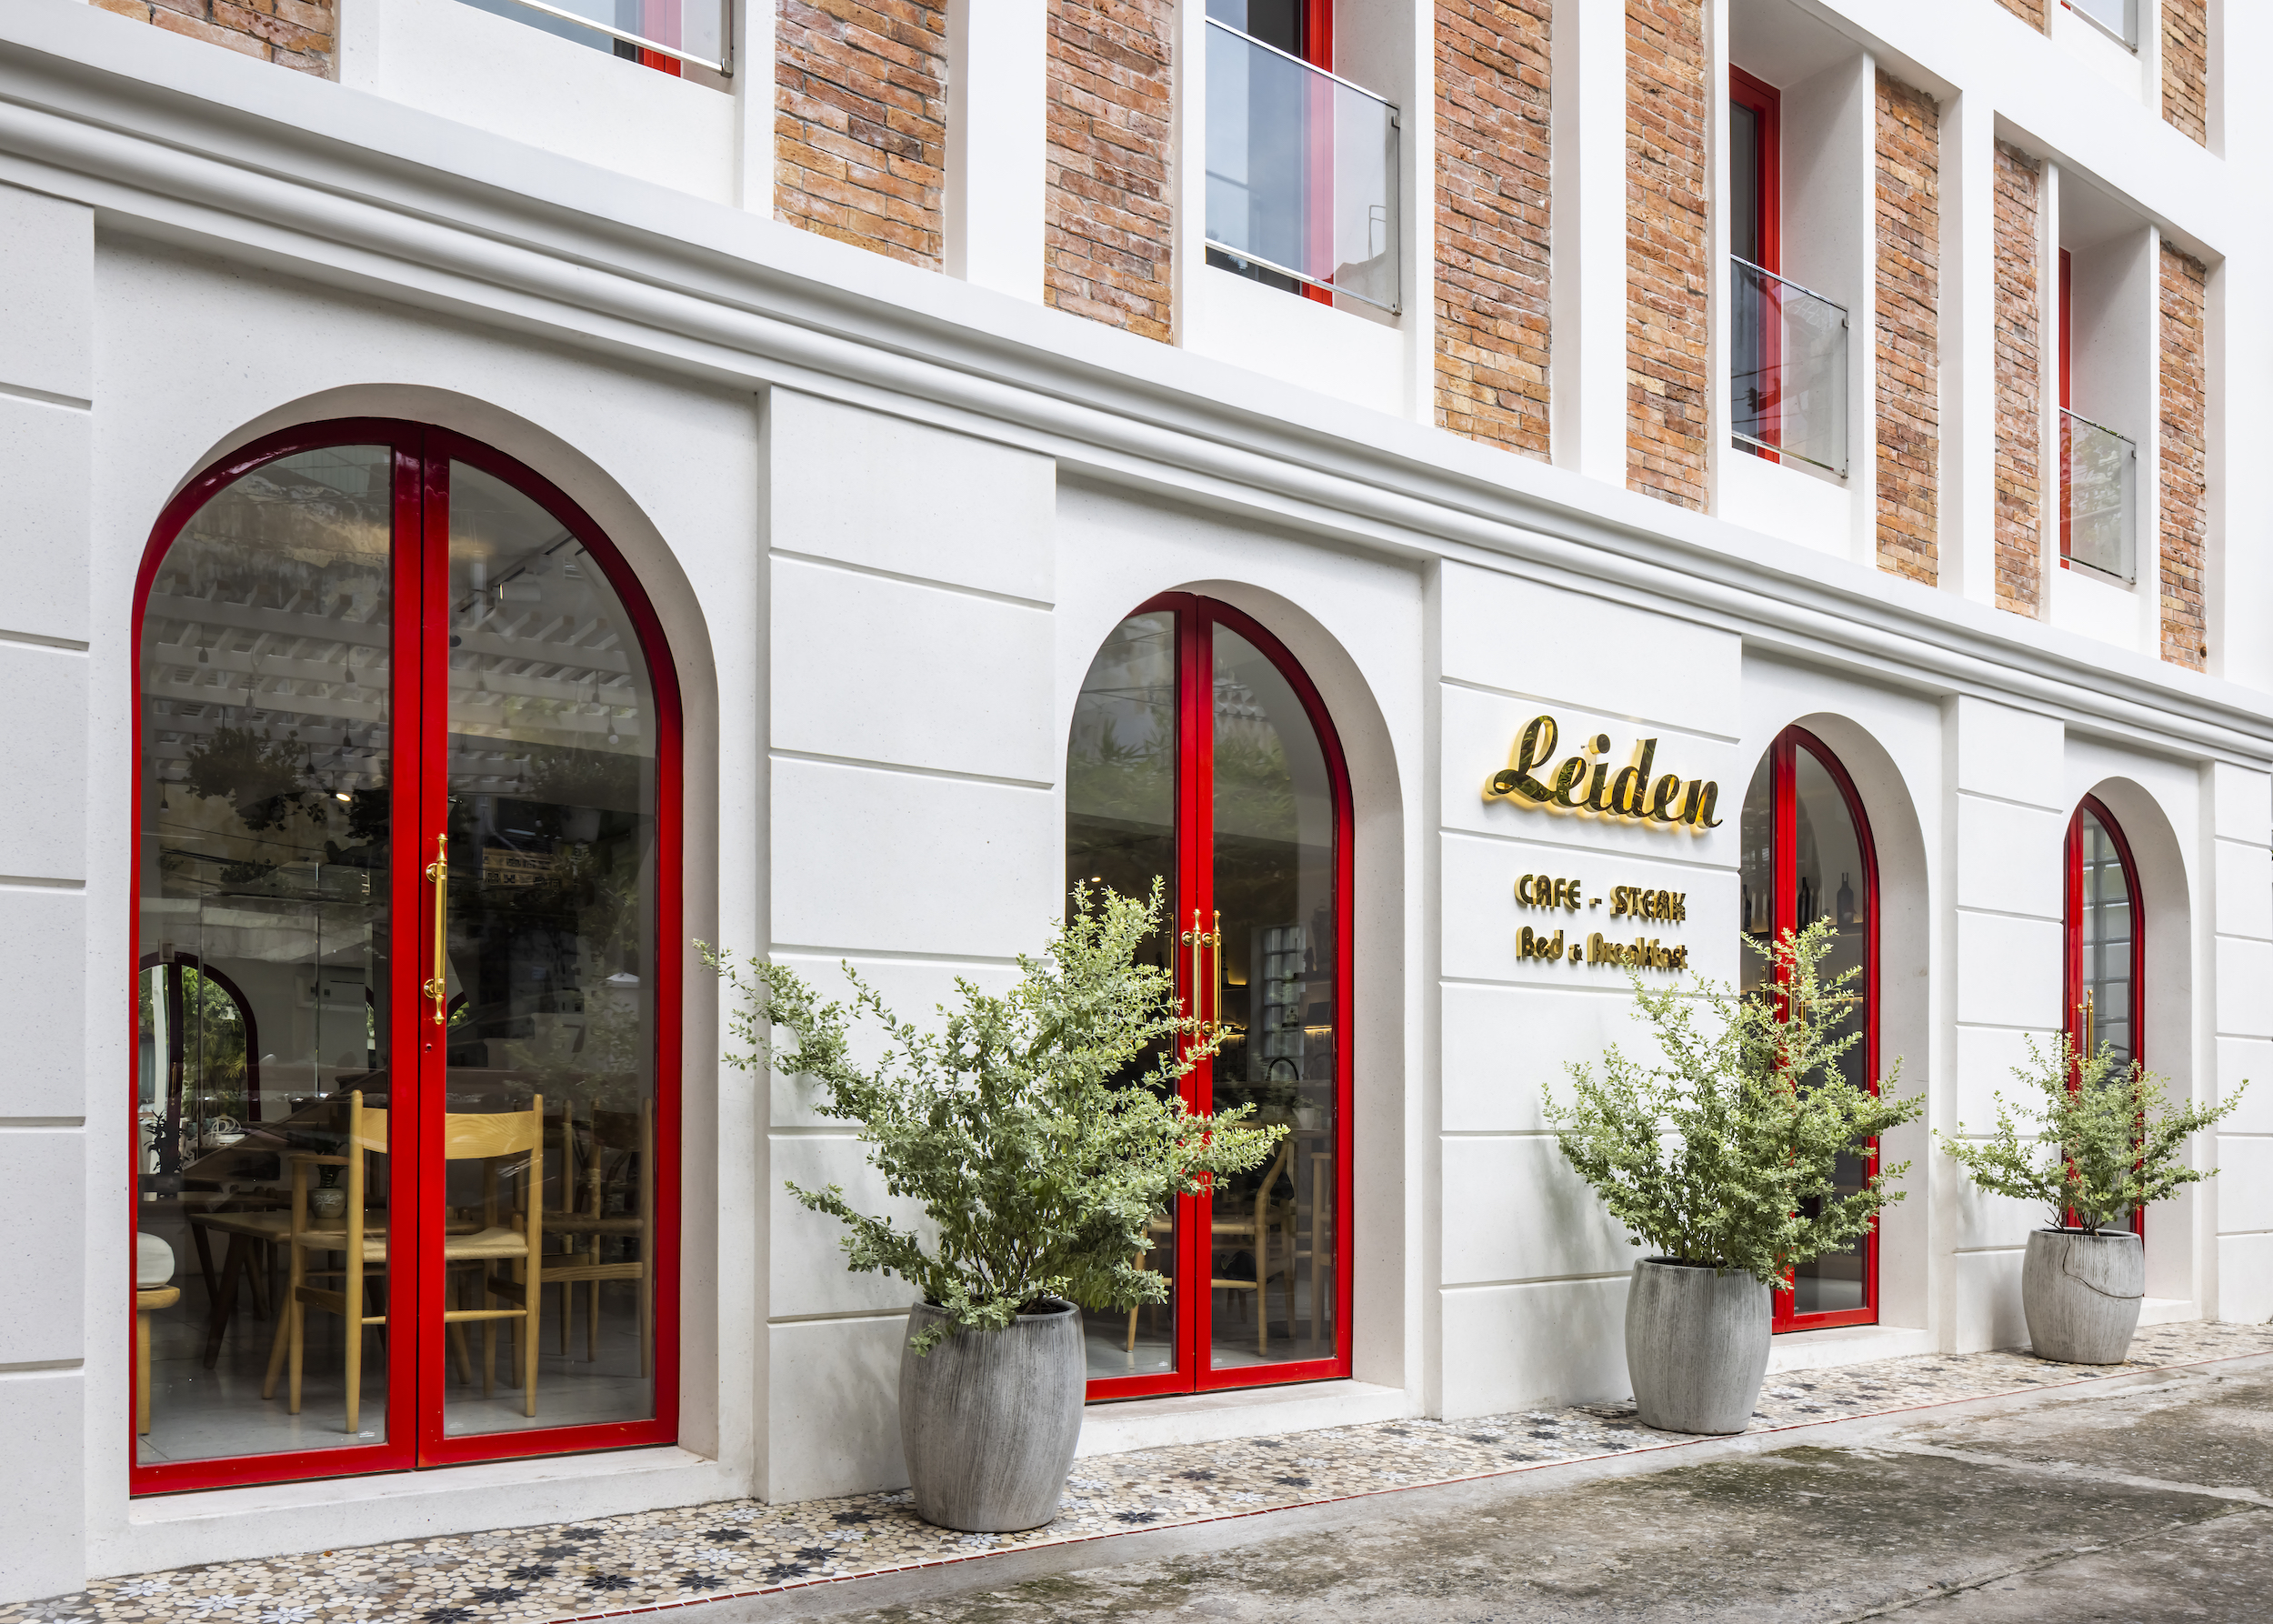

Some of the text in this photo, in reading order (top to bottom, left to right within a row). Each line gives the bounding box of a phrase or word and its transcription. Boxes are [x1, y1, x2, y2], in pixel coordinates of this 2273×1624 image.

[1485, 715, 1723, 828] Leiden
[1514, 874, 1581, 910] CAFE
[1610, 886, 1687, 921] STEAK
[1516, 926, 1564, 960] Bed
[1587, 932, 1688, 969] Breakfast
